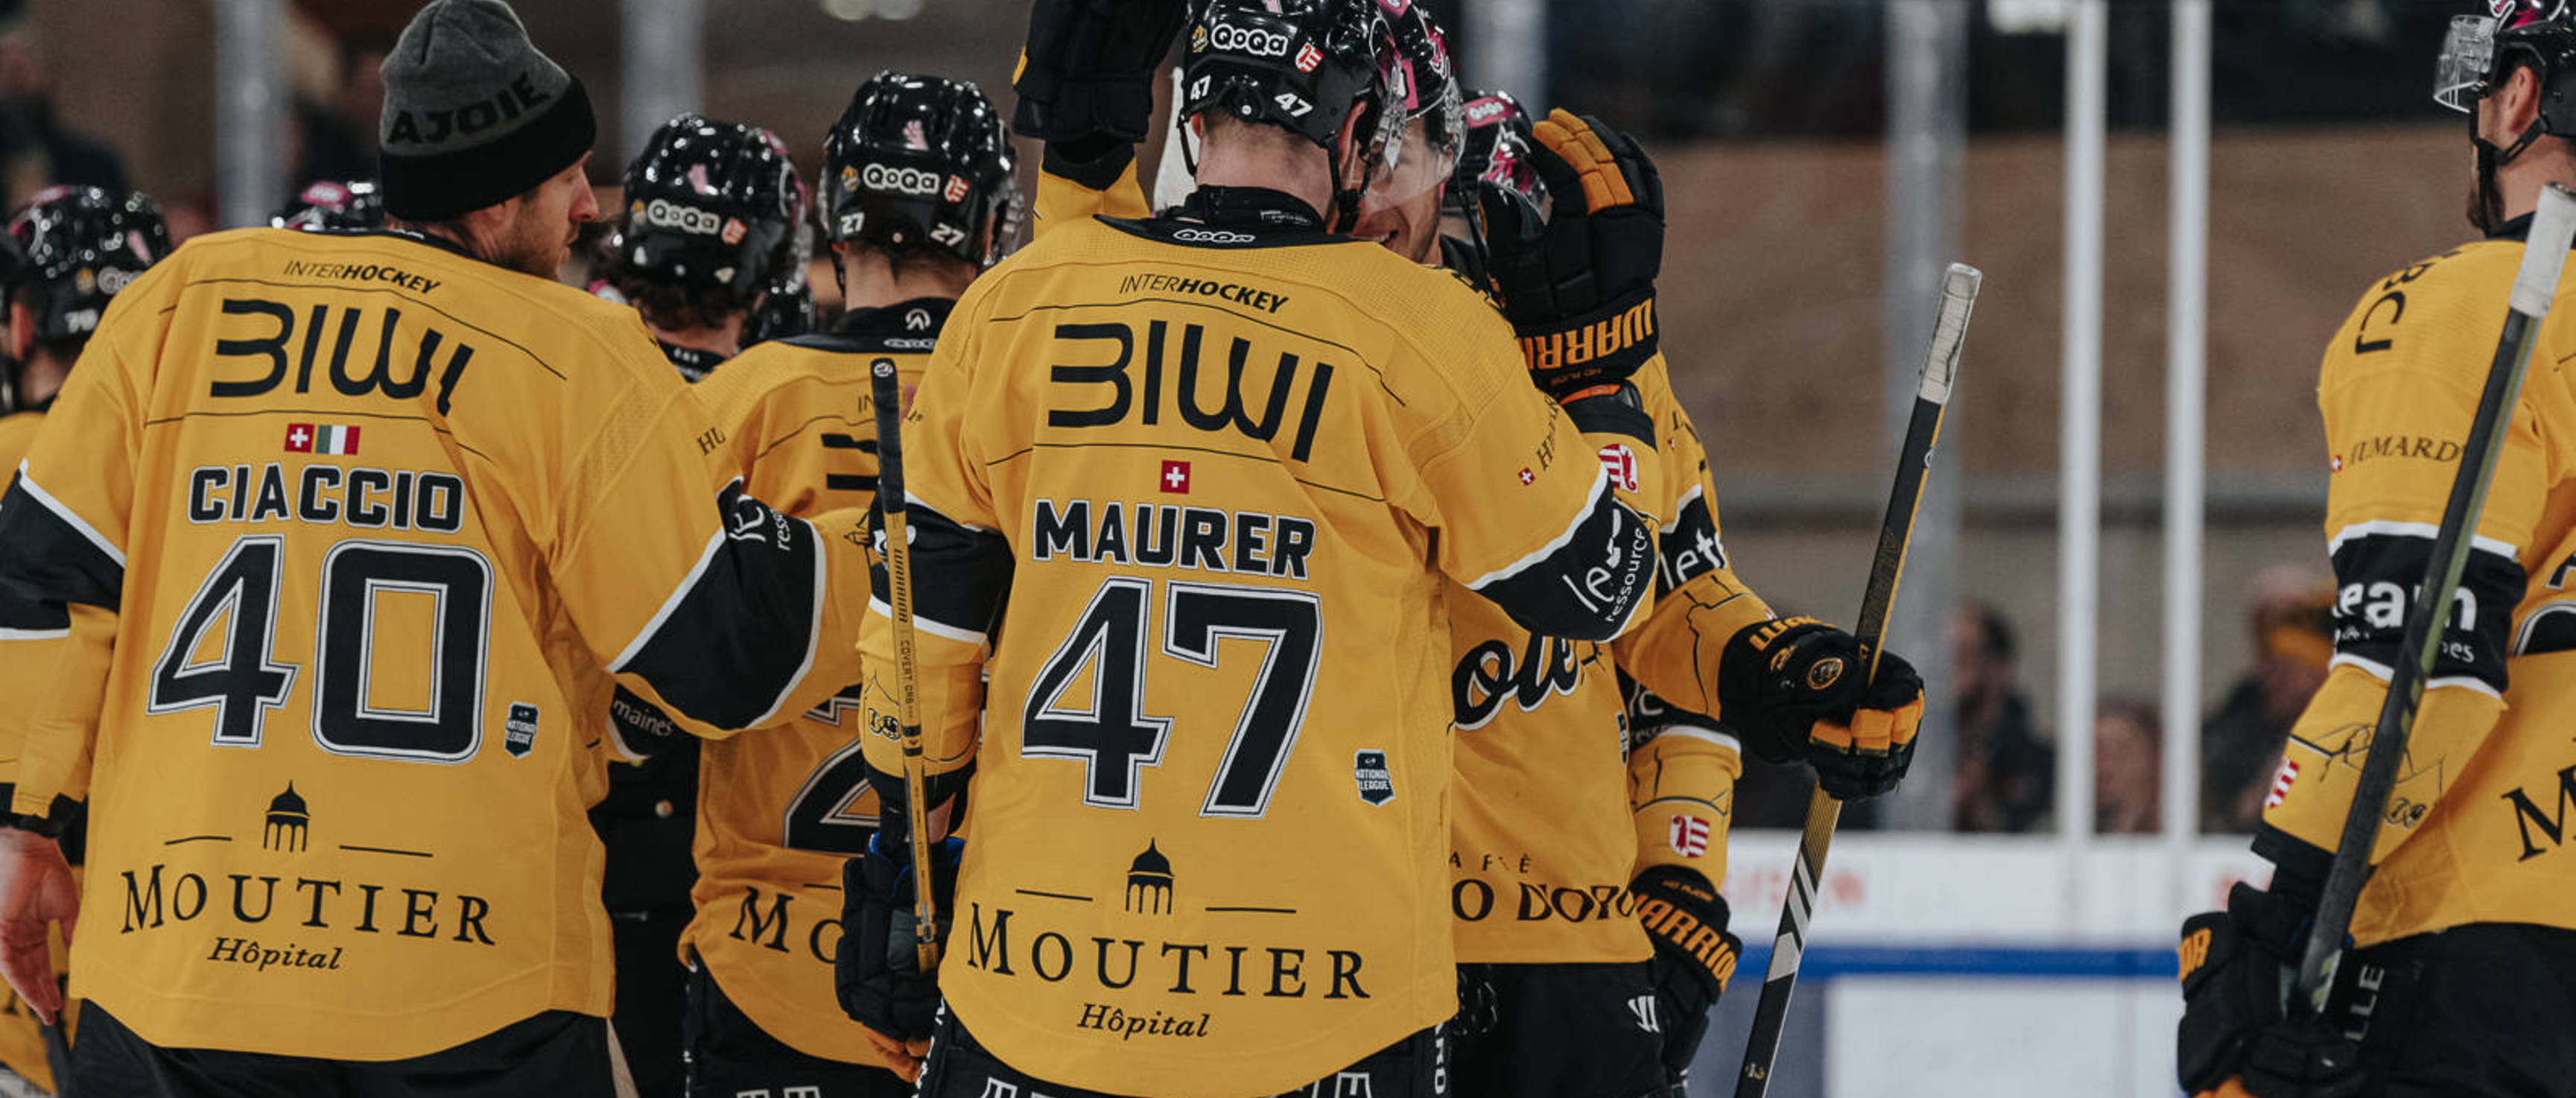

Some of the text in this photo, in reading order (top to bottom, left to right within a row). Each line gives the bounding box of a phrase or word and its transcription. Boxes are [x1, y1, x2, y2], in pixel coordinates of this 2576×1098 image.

[1211, 23, 1289, 56] QoQa
[1190, 74, 1211, 100] 47
[1274, 92, 1313, 118] 47
[386, 72, 551, 144] AJOIE
[863, 163, 940, 194] QoQa
[647, 199, 721, 235] QoQa
[841, 212, 864, 235] 27
[931, 223, 965, 247] 27
[283, 260, 441, 294] INTERHOCKEY
[1119, 273, 1289, 314] INTERHOCKEY
[210, 299, 475, 416] BIWI
[1048, 320, 1333, 463] BIWI
[188, 462, 465, 533] CIACCIO
[1032, 498, 1316, 580] MAURER
[145, 533, 495, 765] 40
[1021, 575, 1324, 819] 47
[120, 864, 496, 947] MOUTIER
[207, 936, 345, 971] Hôpital
[967, 902, 1371, 1000] MOUTIER
[1077, 1003, 1211, 1041] Hôpital
